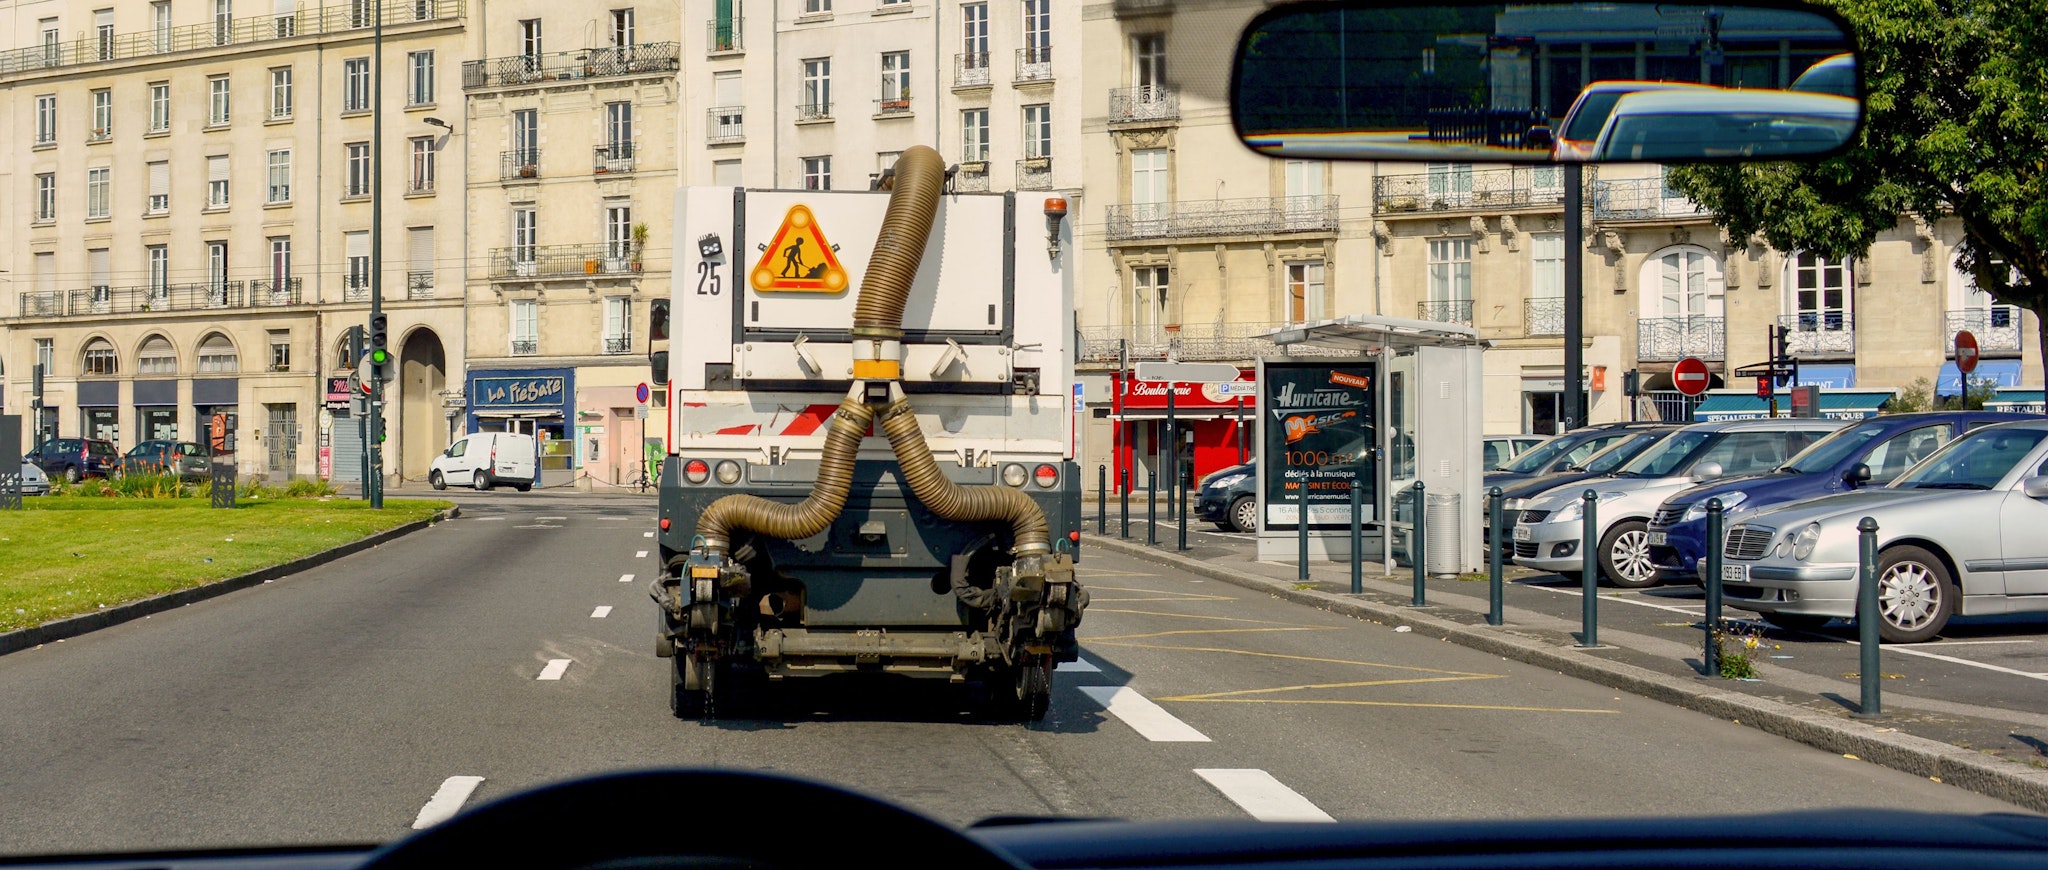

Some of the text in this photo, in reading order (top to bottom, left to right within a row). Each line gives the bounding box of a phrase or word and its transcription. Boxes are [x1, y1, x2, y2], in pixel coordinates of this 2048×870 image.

[697, 261, 721, 295] 25
[1333, 375, 1365, 386] NOUVEAU
[1274, 382, 1360, 407] Hurricane
[1996, 405, 2046, 414] RESTAUR
[1285, 451, 1328, 466] 1000
[1316, 470, 1323, 478] la
[1324, 470, 1356, 479] musique
[1285, 482, 1320, 490] MASIN
[1321, 482, 1330, 490] ET
